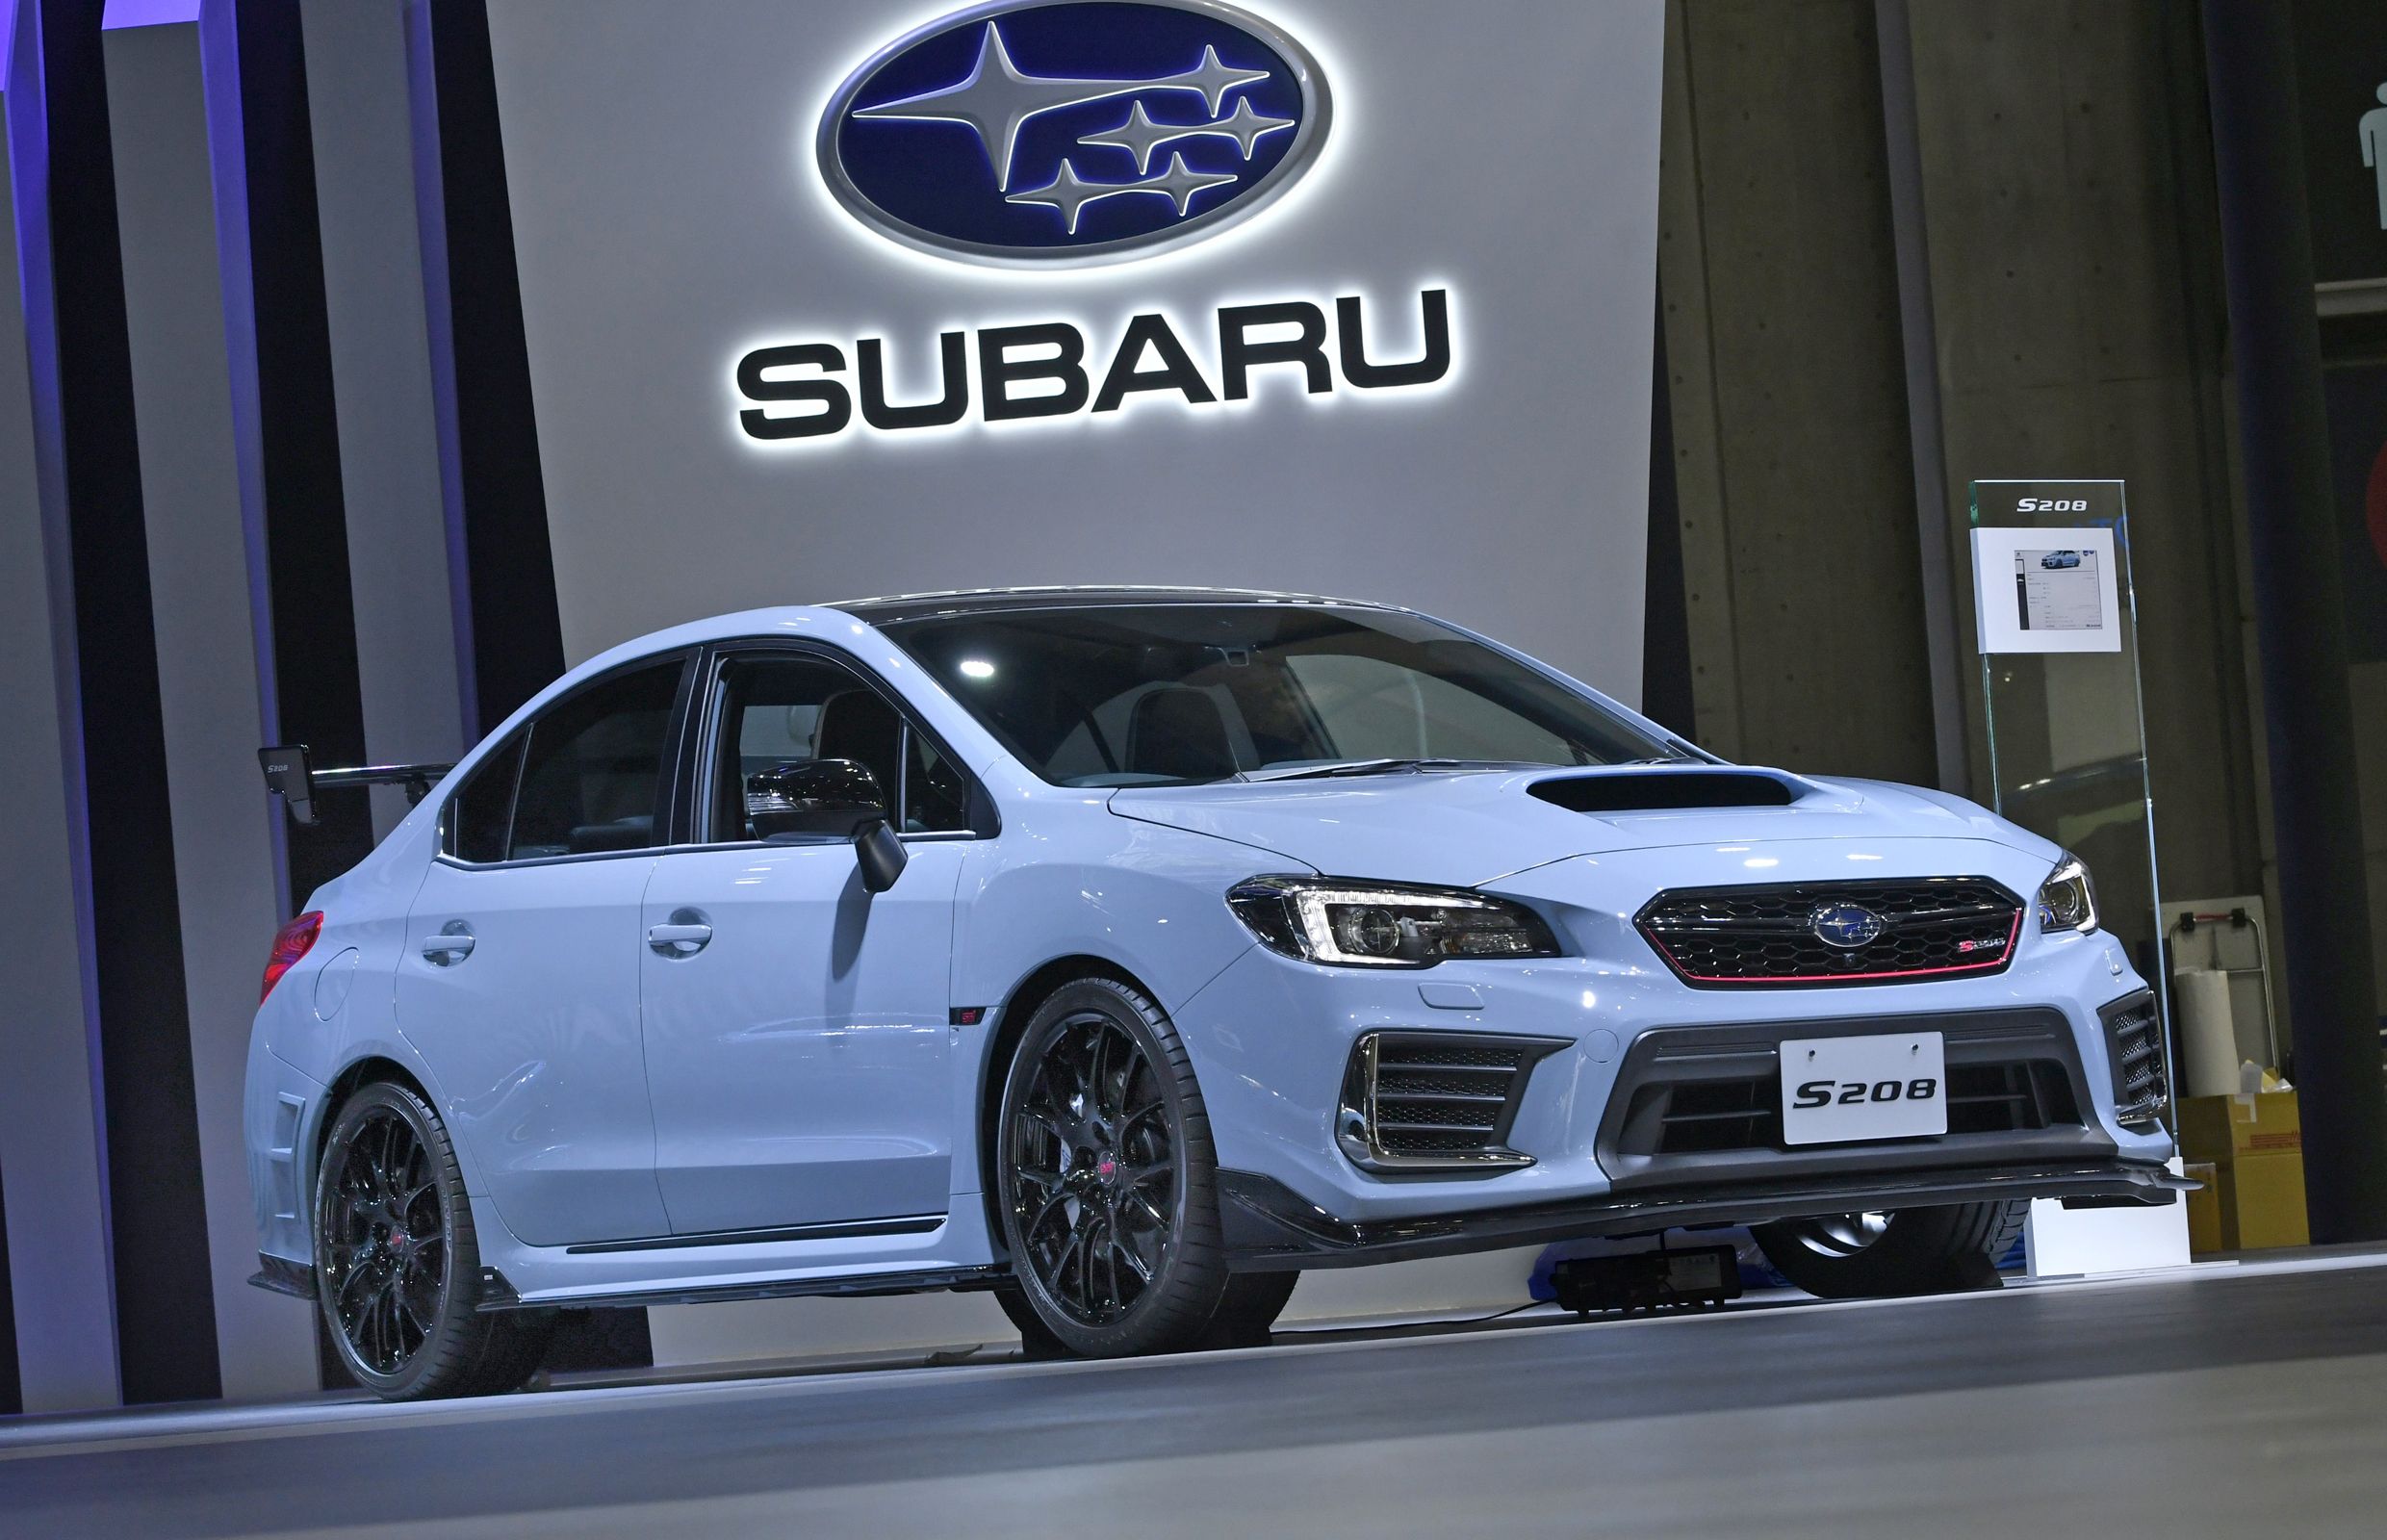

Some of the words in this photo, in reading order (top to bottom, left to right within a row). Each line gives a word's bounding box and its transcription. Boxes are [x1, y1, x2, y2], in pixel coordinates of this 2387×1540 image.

[736, 288, 1450, 441] SUBARU
[2016, 498, 2087, 512] S208
[1792, 1078, 1937, 1110] S208
